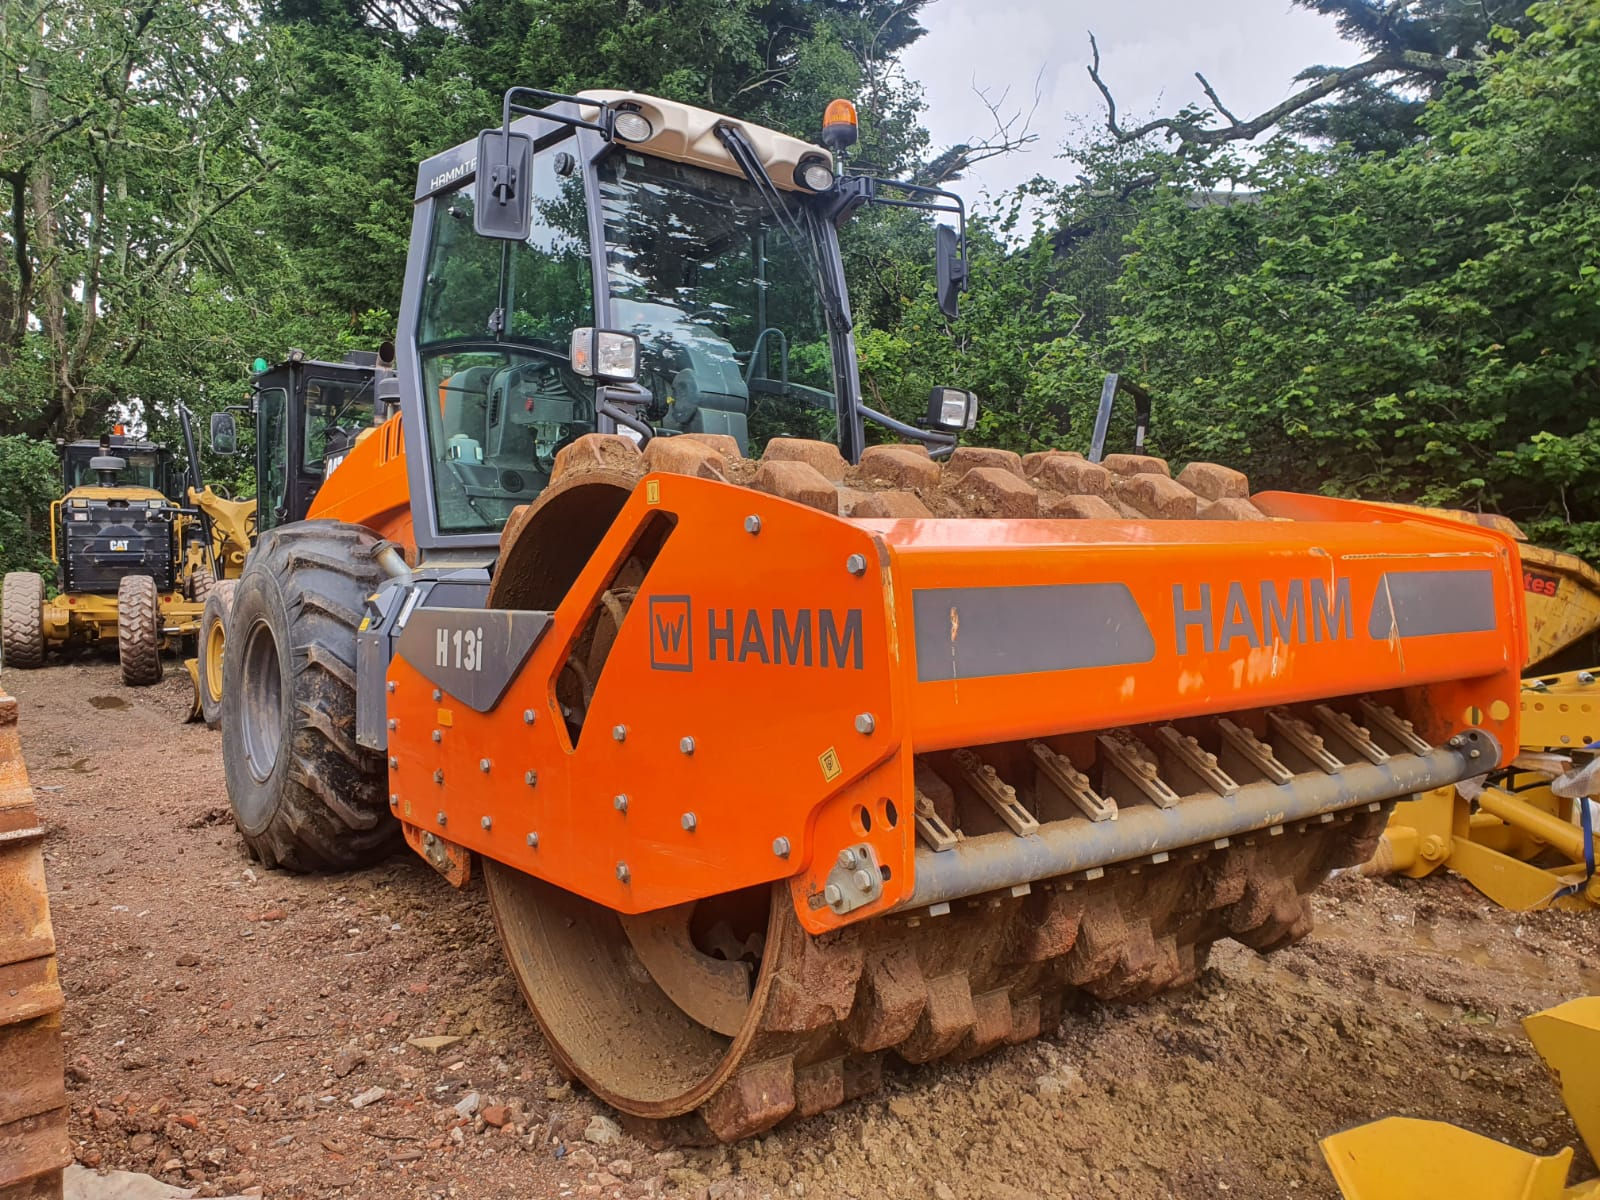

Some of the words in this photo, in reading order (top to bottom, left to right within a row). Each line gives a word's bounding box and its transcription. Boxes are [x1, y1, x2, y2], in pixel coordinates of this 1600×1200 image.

[110, 540, 129, 551] CAT
[707, 608, 864, 670] HAMM
[1172, 577, 1354, 656] HAMM
[436, 628, 449, 667] H
[452, 626, 483, 671] 13i
